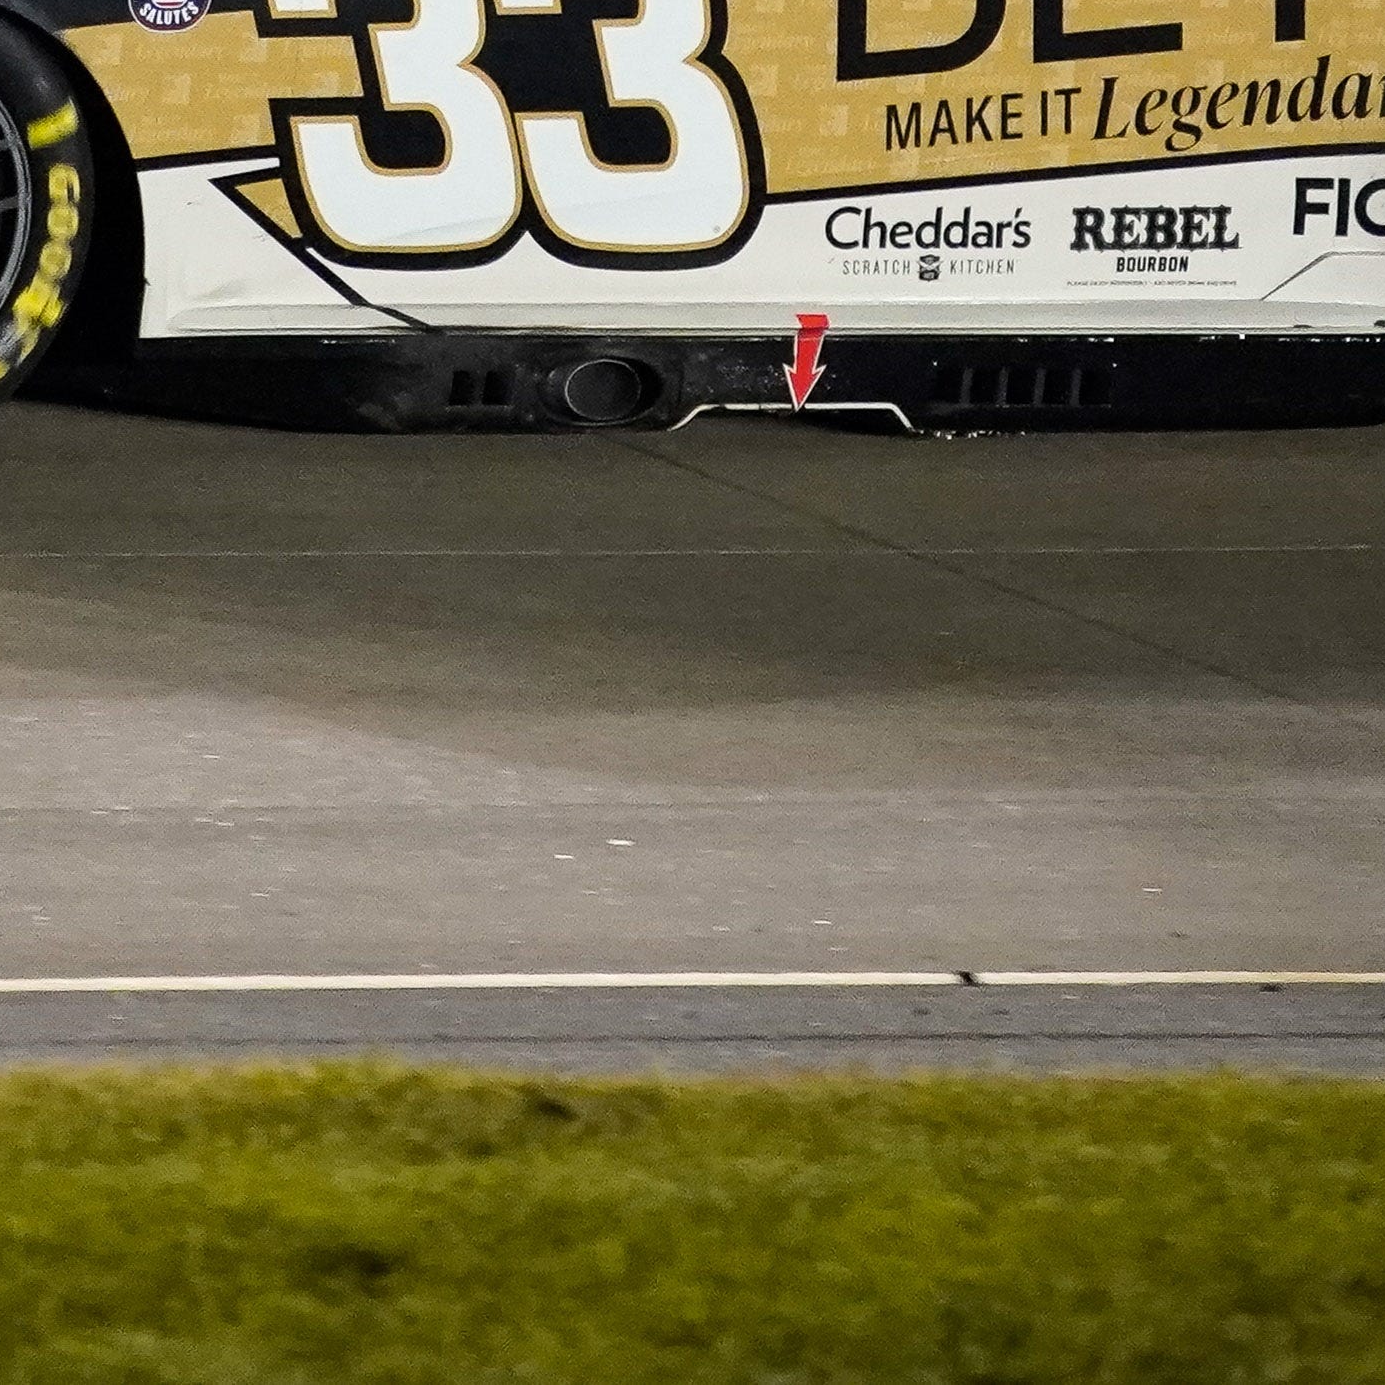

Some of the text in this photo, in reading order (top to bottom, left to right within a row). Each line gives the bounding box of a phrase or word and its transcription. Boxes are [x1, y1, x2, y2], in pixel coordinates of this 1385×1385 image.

[139, 1, 199, 25] SALUTES
[884, 91, 1024, 151] MAKE
[1040, 87, 1082, 137] IT
[825, 206, 1032, 250] Cheddar's
[1070, 205, 1242, 253] REBEL
[842, 259, 1015, 276] SCRATCH KITCHEN
[1116, 256, 1189, 273] BOURBON
